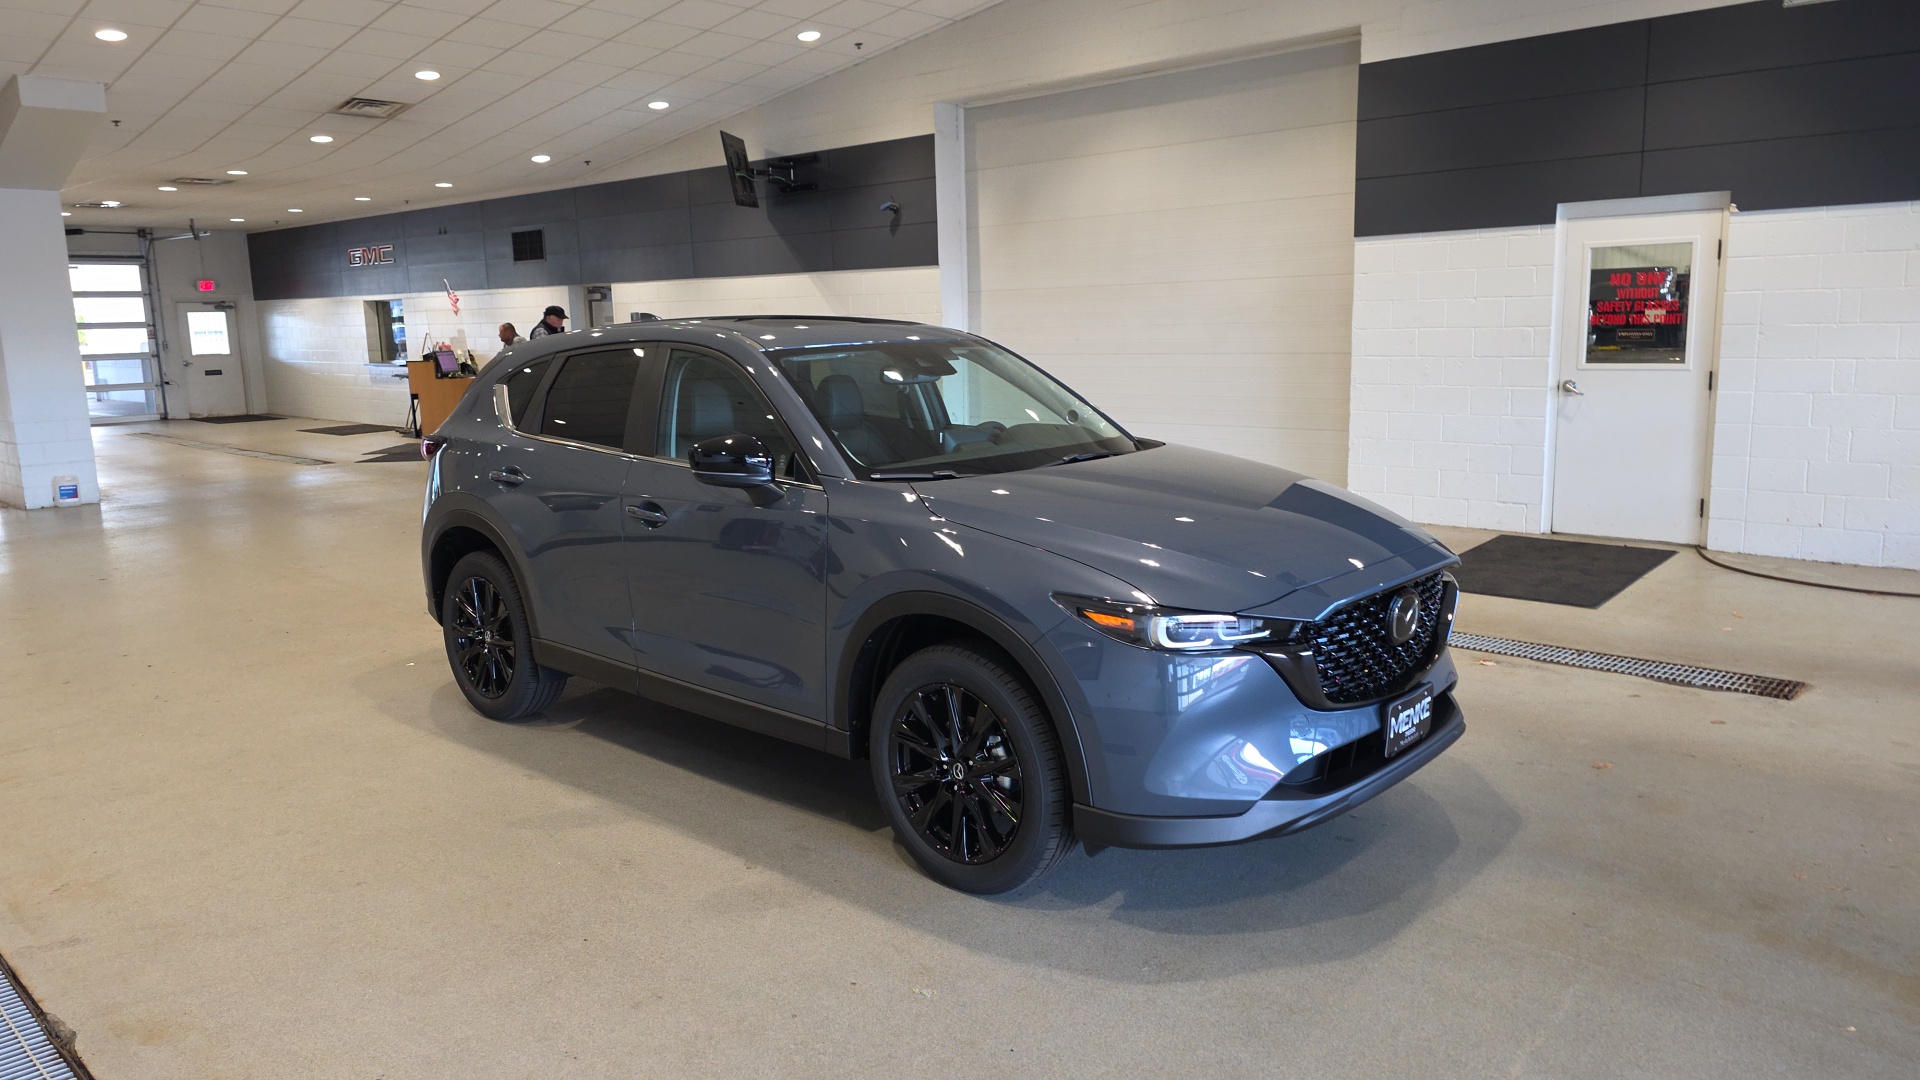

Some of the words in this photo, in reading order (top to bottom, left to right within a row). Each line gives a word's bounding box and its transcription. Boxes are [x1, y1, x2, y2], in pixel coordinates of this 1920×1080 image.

[348, 244, 395, 267] GMC
[1610, 272, 1632, 286] NO
[1637, 271, 1668, 286] ONE
[1617, 287, 1660, 299] WITHOUT
[1596, 300, 1633, 312] SAFETY
[1634, 300, 1679, 311] GLASSES
[1590, 313, 1627, 325] BEYOND
[1629, 313, 1651, 325] THIS
[1390, 696, 1431, 739] MENKE
